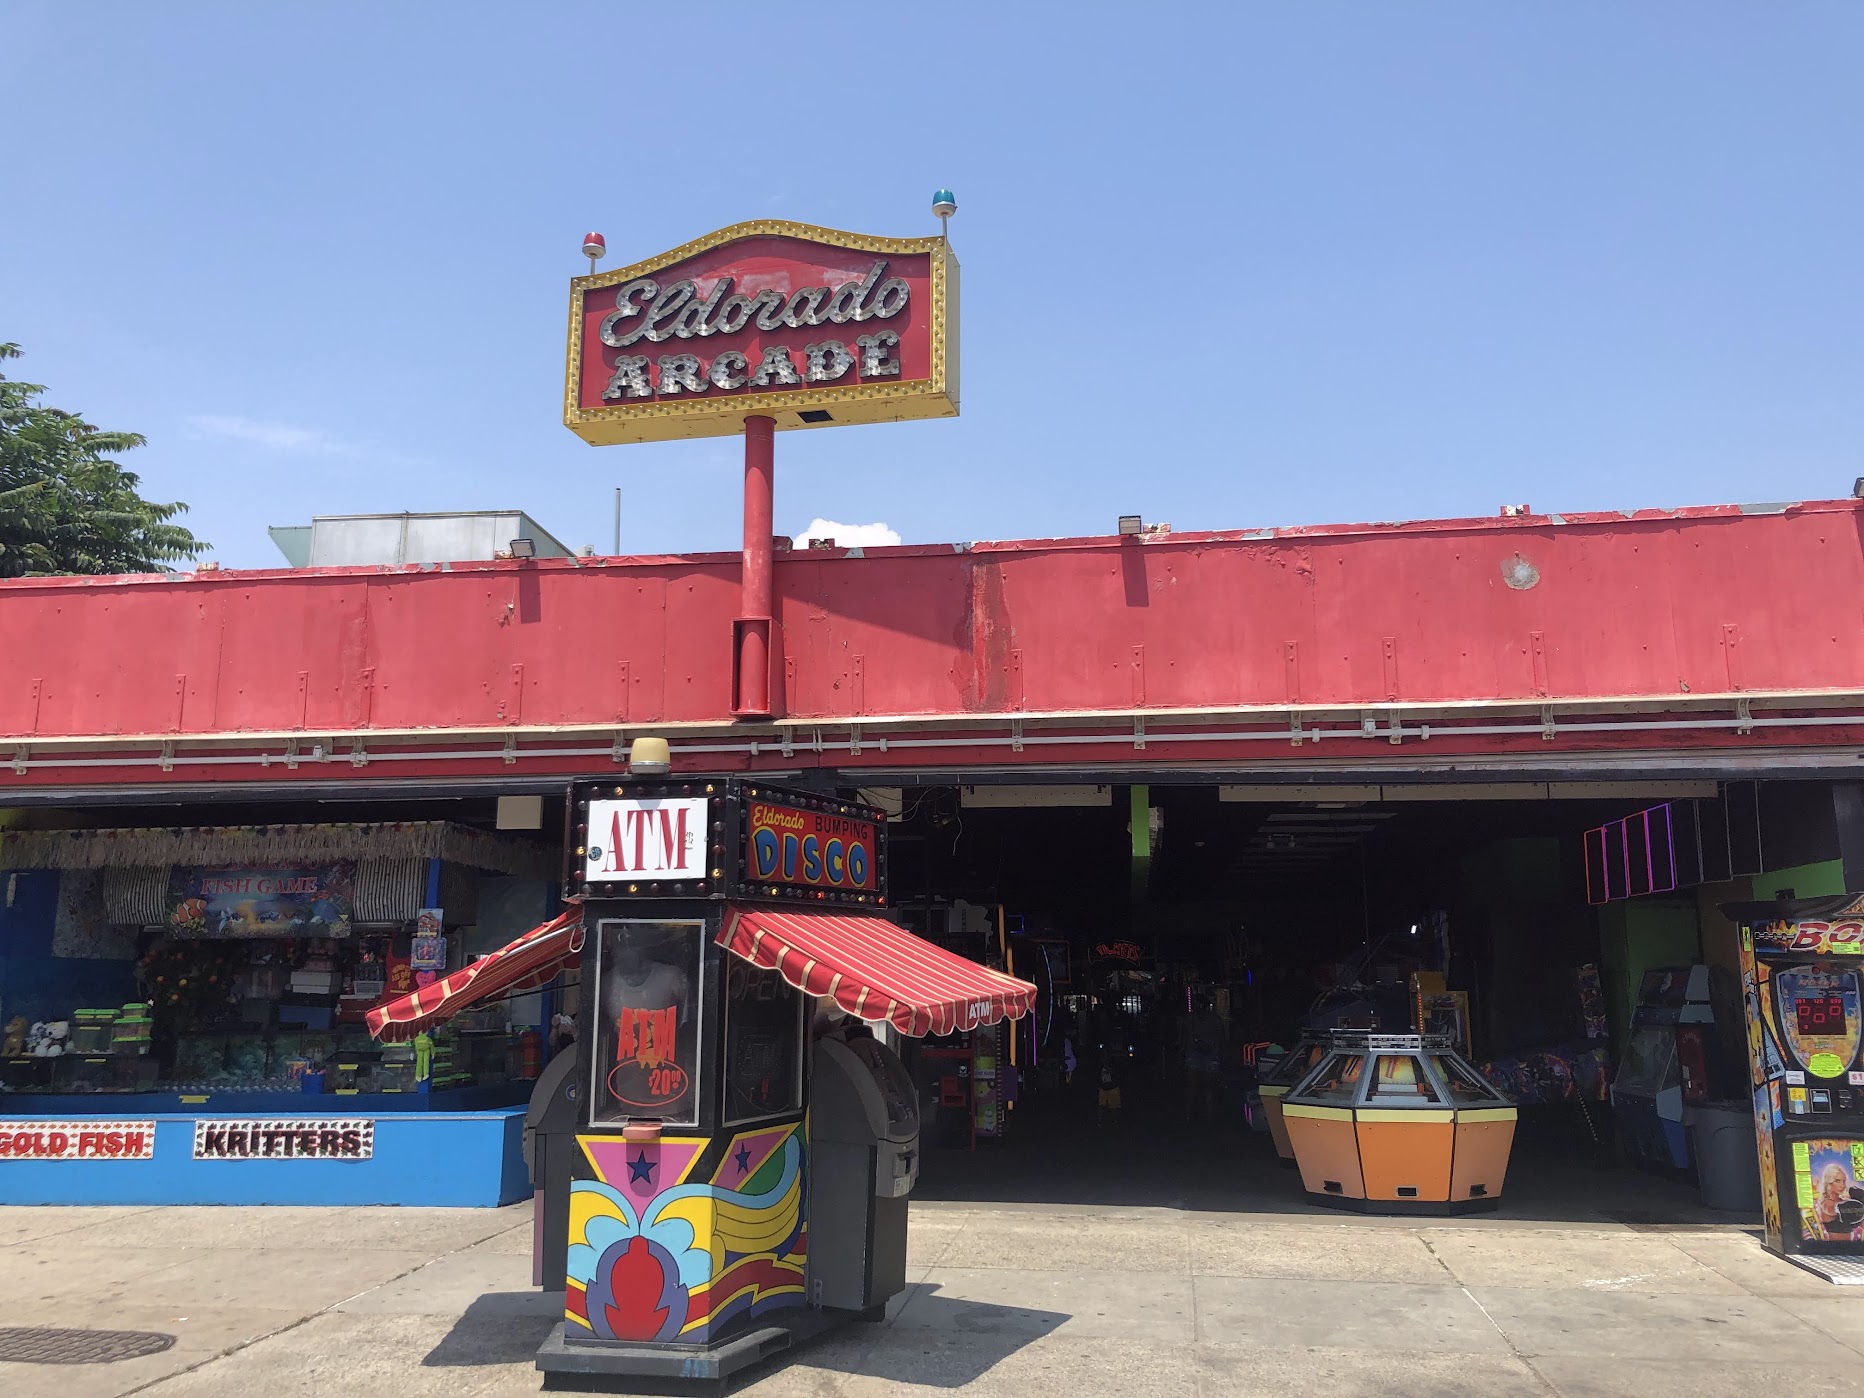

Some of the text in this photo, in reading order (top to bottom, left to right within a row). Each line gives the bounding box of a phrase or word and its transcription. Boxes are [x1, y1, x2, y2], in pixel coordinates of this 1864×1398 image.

[600, 261, 910, 347] Eldorado
[602, 330, 899, 399] ARCADE
[753, 806, 868, 839] Eldorado BUMPING
[601, 808, 690, 872] ATM
[752, 826, 868, 887] DISCO
[200, 877, 317, 895] FISH GAME
[1790, 921, 1864, 950] BO
[969, 1001, 990, 1019] ATM
[616, 1005, 677, 1062] ATM
[0, 1132, 145, 1155] GOLD FISH
[204, 1130, 361, 1155] KRITTERS
